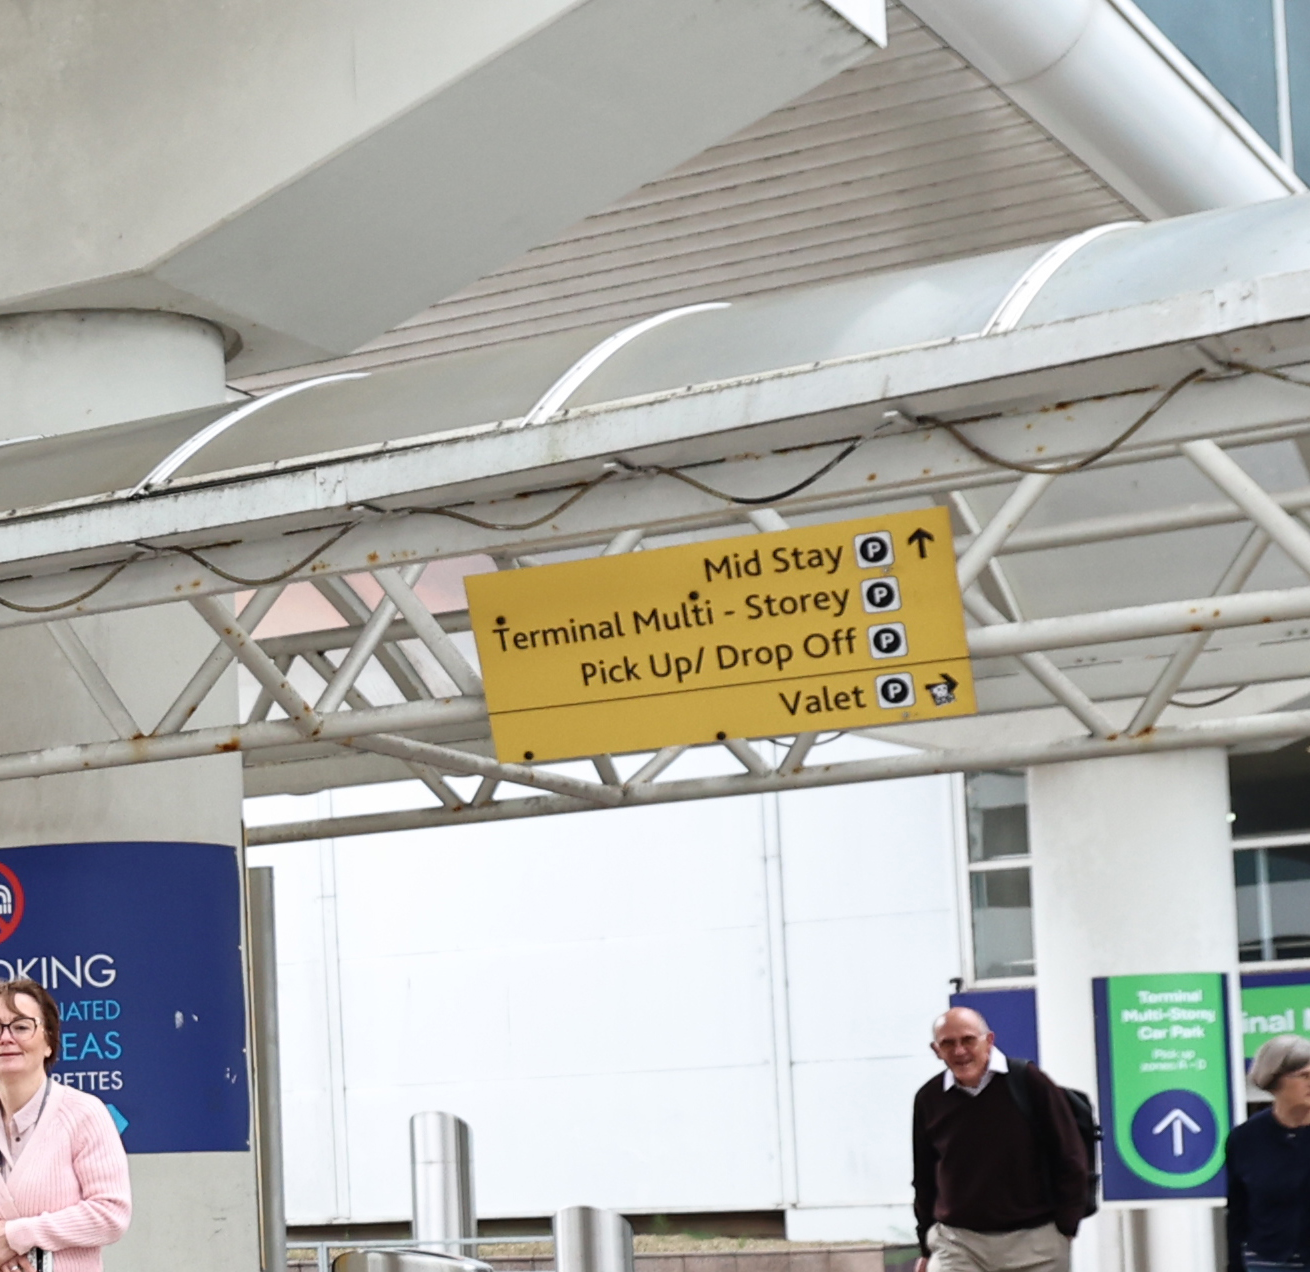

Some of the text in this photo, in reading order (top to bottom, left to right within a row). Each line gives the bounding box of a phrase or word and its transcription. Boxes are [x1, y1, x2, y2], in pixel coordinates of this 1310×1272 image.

[704, 549, 762, 582] Mid
[772, 546, 843, 574] Stay
[492, 611, 625, 652] Terminal
[632, 600, 714, 634] Multi
[745, 588, 850, 620] Storey
[580, 656, 642, 686] Pick
[649, 647, 705, 684] Up/
[716, 643, 793, 671] Drop
[803, 627, 857, 659] Off
[779, 686, 867, 716] Valet
[60, 1000, 121, 1022] NATED
[1137, 989, 1203, 1004] Terminal
[1137, 1025, 1205, 1041] Car Park
[1241, 1008, 1295, 1034] inal
[59, 1031, 123, 1061] EAS
